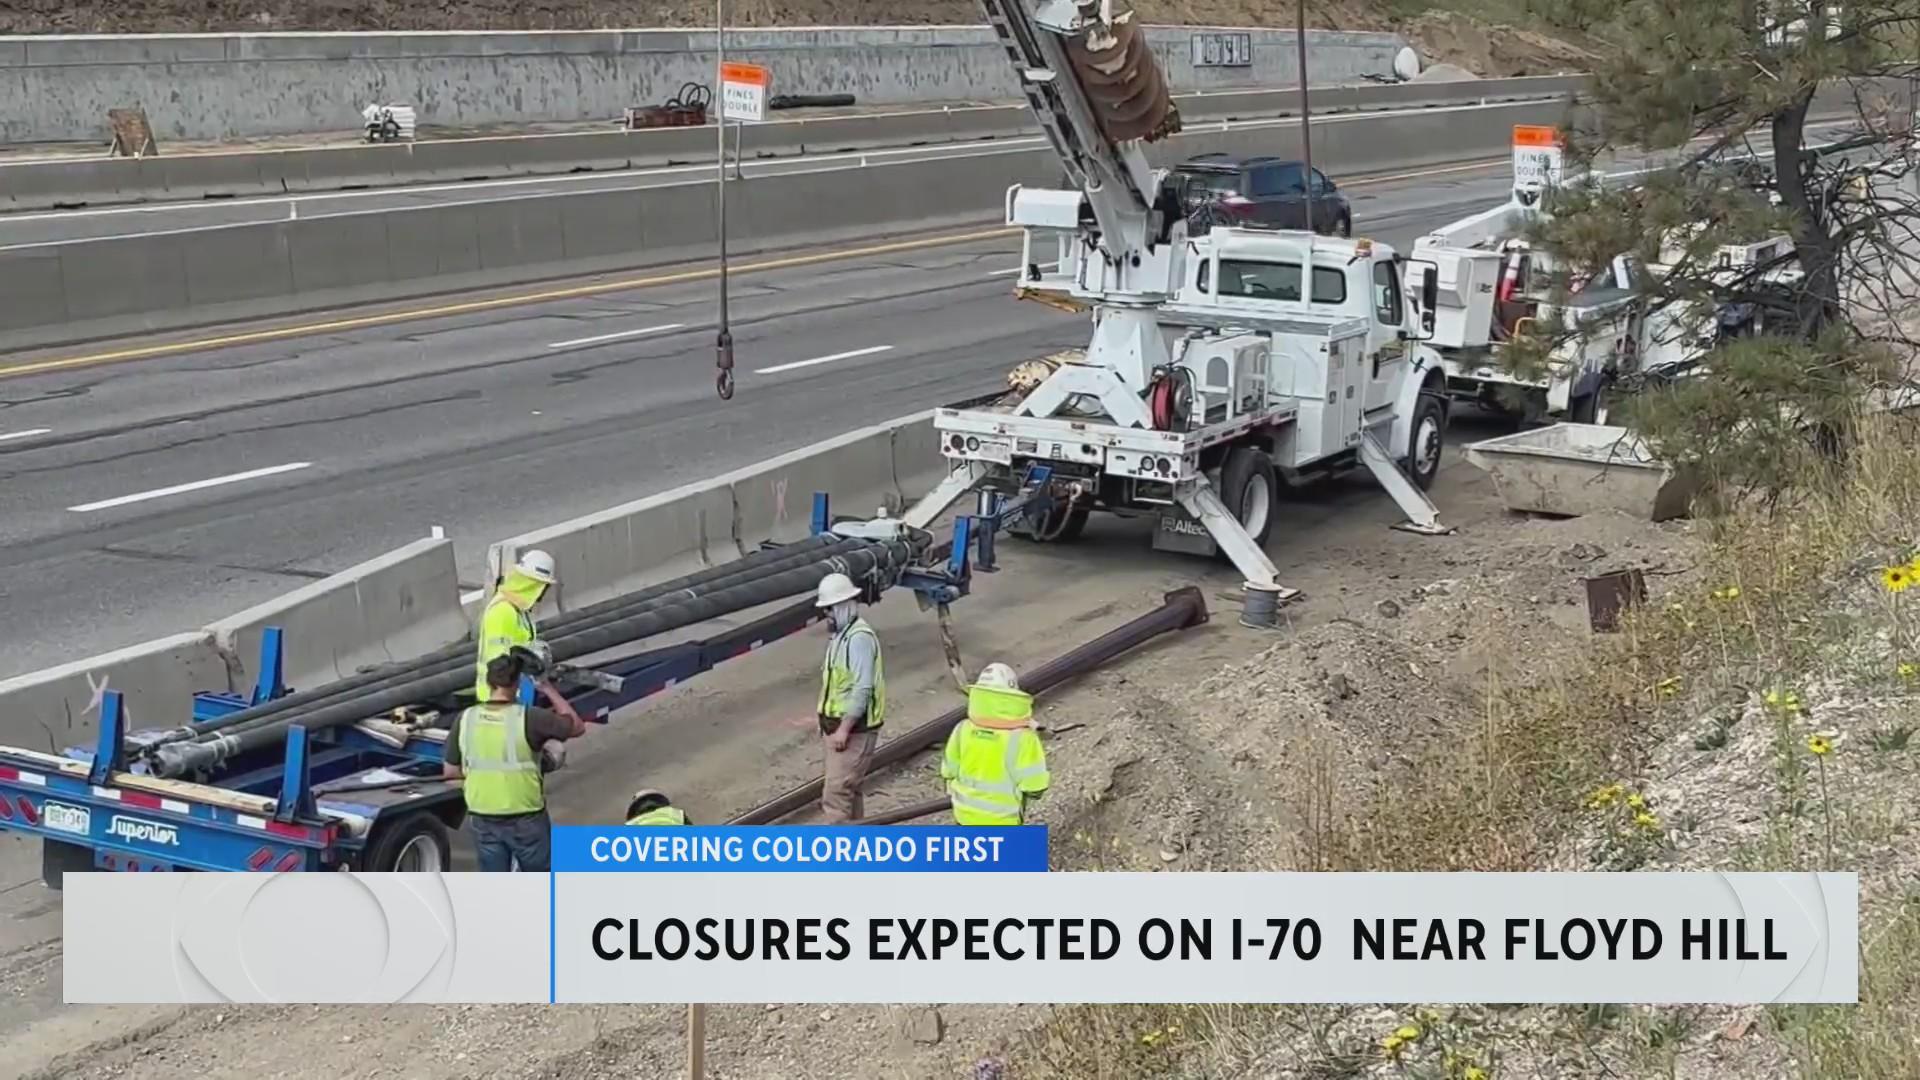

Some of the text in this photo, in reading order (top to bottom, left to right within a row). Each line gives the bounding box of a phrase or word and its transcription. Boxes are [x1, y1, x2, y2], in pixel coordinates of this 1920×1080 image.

[727, 88, 754, 99] FINES
[1517, 166, 1558, 177] DOUBE
[1175, 519, 1207, 536] Altec
[105, 815, 180, 846] Superior
